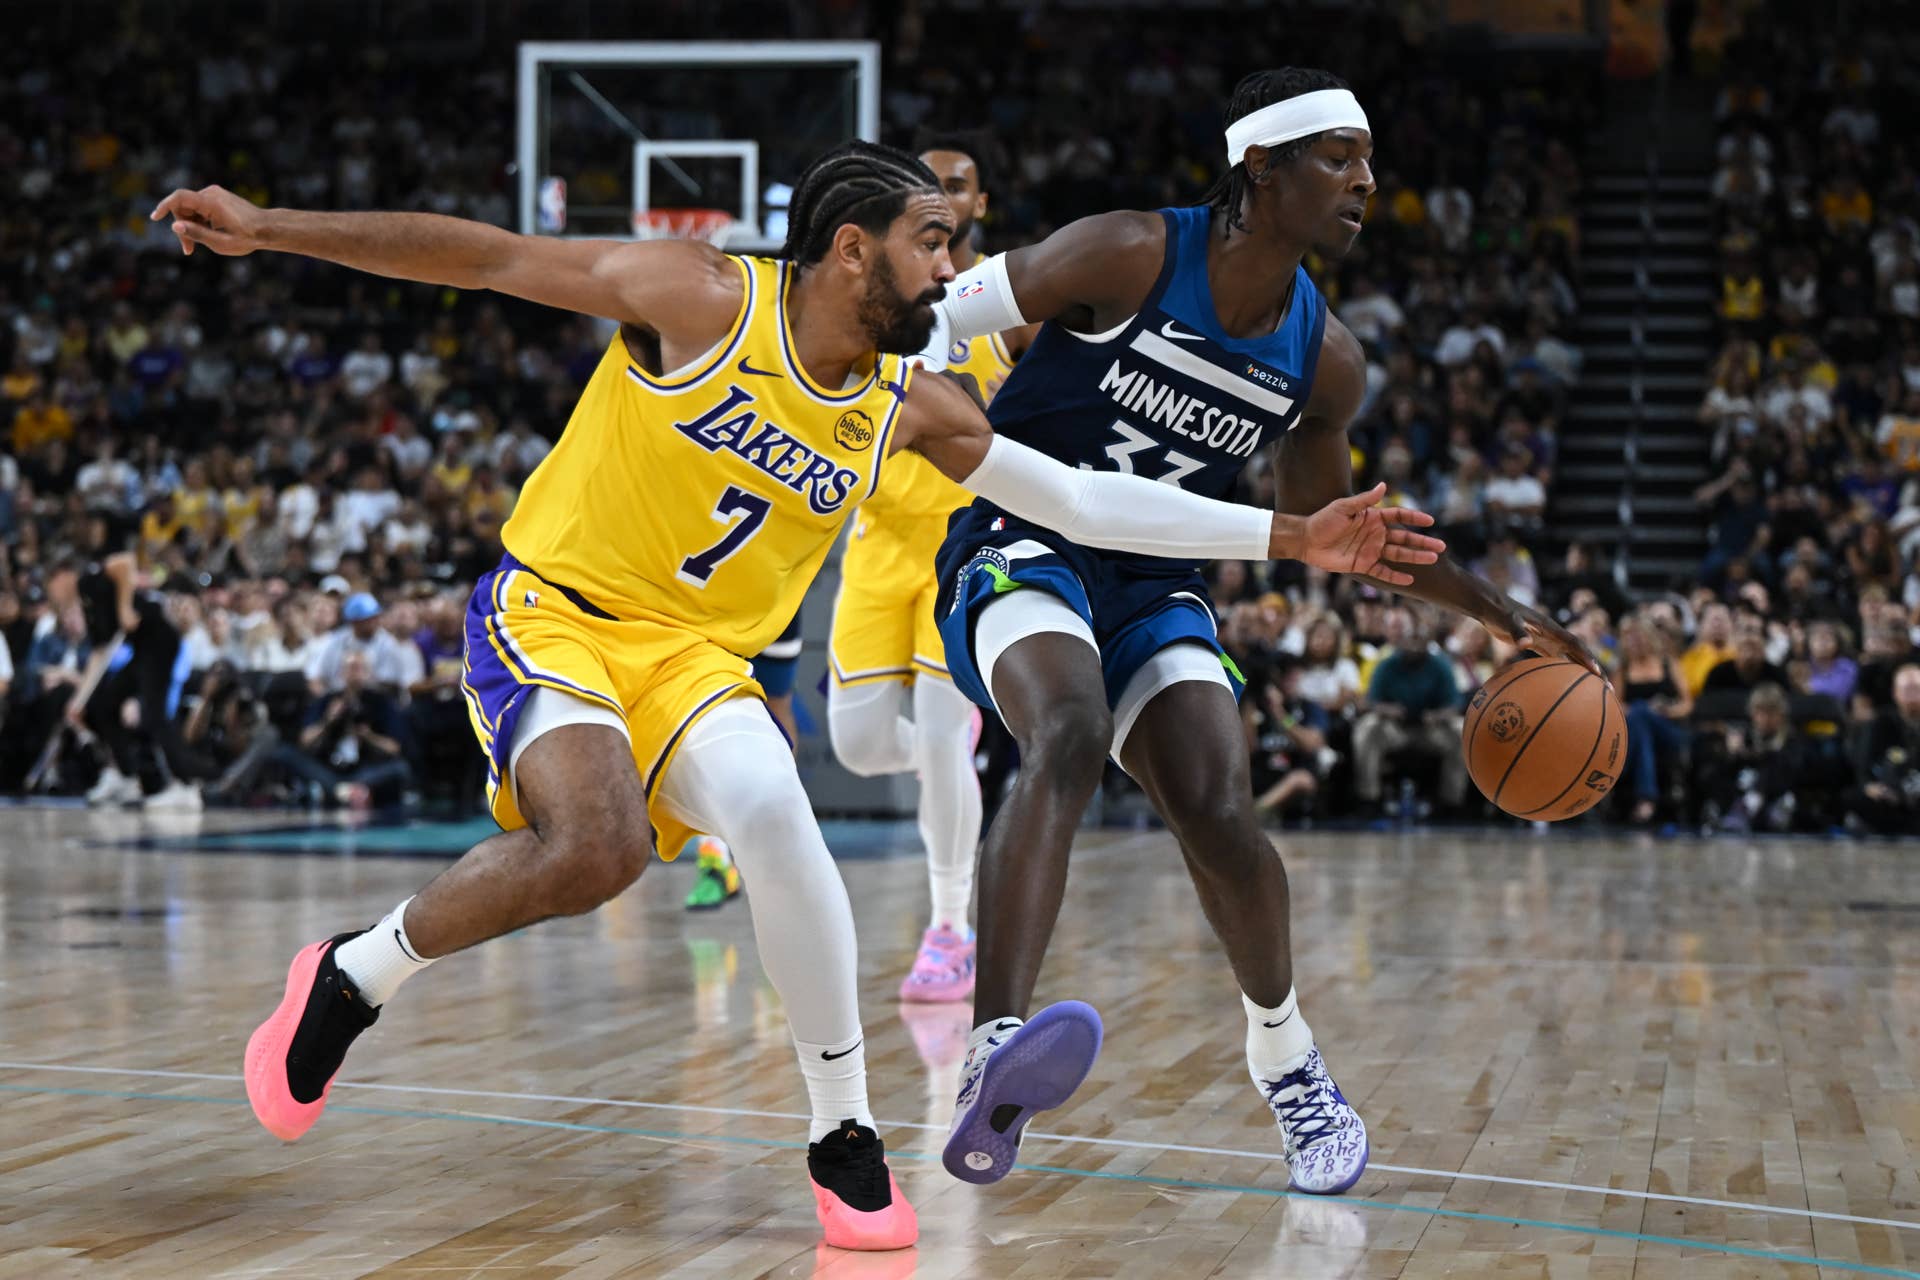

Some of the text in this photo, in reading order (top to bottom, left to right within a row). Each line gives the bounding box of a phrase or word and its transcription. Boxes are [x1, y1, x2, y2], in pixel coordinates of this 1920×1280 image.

[1098, 359, 1263, 457] MINNESOTA
[1253, 368, 1289, 391] sezzle
[672, 384, 861, 516] LAKERS
[840, 416, 871, 442] bibigo
[674, 483, 773, 590] 7
